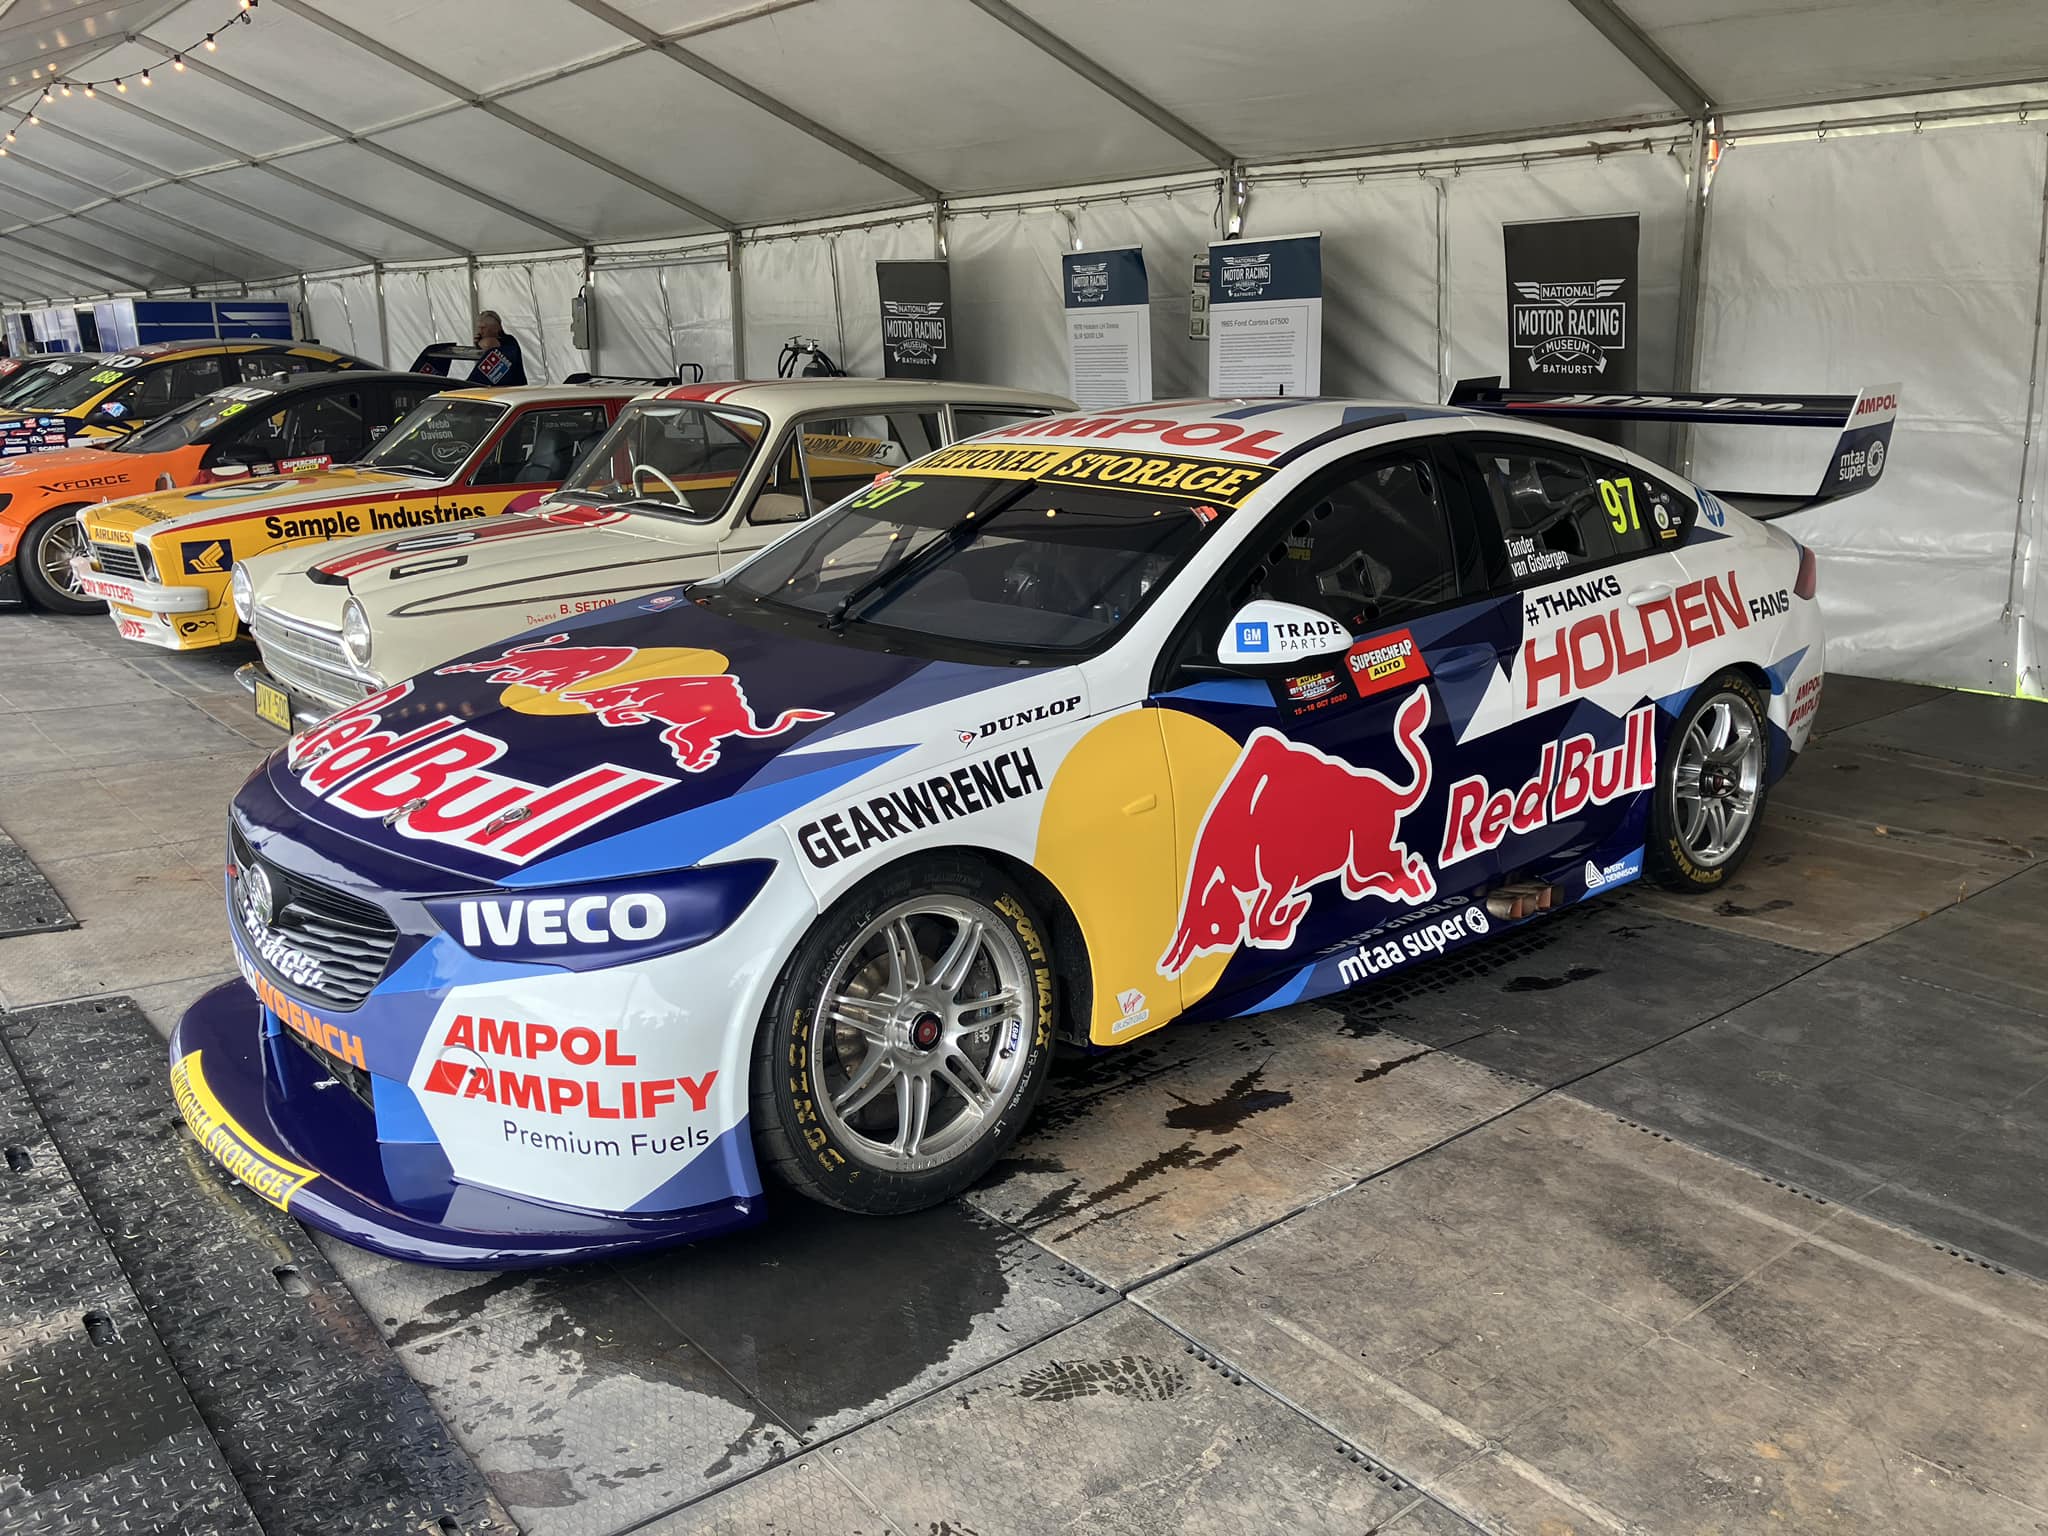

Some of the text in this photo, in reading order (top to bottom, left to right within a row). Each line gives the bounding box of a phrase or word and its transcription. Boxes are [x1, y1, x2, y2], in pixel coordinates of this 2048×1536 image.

[1223, 266, 1269, 281] MOTOR RACING
[1542, 285, 1595, 297] NATIONAL
[898, 305, 928, 313] NATIONAL
[886, 319, 943, 340] MOTOR RACING
[1234, 319, 1248, 327] Ford
[1269, 317, 1290, 325] GT500
[1518, 308, 1619, 335] MOTOR RACING
[902, 340, 928, 351] MUSEUM
[1545, 339, 1590, 353] MUSEUM
[1542, 364, 1594, 374] BATHURST
[1855, 393, 1897, 415] AMPOL
[421, 430, 454, 440] Davison
[977, 417, 1284, 460] AMPOL
[282, 457, 328, 469] SUPERCHEAP
[1840, 450, 1866, 466] mtaa
[912, 445, 1262, 498] NATIONAL STORAGE
[1839, 464, 1866, 481] super
[853, 479, 924, 510] 97
[1600, 477, 1641, 535] 97
[265, 502, 487, 541] Sample Industries
[95, 528, 130, 543] AIRLINES
[1504, 537, 1535, 558] Tander
[1511, 550, 1569, 577] van Gisbergen
[560, 604, 572, 615] B.
[575, 598, 617, 613] SETON
[1525, 574, 1622, 627] #THANKS
[1748, 589, 1790, 623] FANS
[1243, 621, 1342, 642] GM TRADE
[1524, 570, 1751, 710] HOLDEN
[1280, 638, 1327, 651] PARTS
[1350, 639, 1412, 673] SUPERCHEAP
[1300, 674, 1319, 684] AUTO
[1373, 660, 1402, 677] AUTO
[1289, 675, 1336, 695] BATHURST
[1316, 699, 1329, 709] OCT
[1330, 693, 1348, 704] 2020
[979, 696, 1082, 739] DUNLOP
[797, 747, 1044, 869] GEARWRENCH
[1603, 861, 1626, 875] AVERY
[1605, 865, 1640, 884] DENNISON
[460, 893, 667, 947] IVECO
[1337, 914, 1467, 985] mtaa super
[994, 893, 1046, 963] SPORT
[1034, 967, 1053, 1052] MAXX
[443, 1014, 637, 1066] AMPOL
[463, 1068, 720, 1120] AMPLIFY
[170, 1058, 295, 1199] NATIONAL STORAGE
[503, 1120, 710, 1157] Premium Fuels
